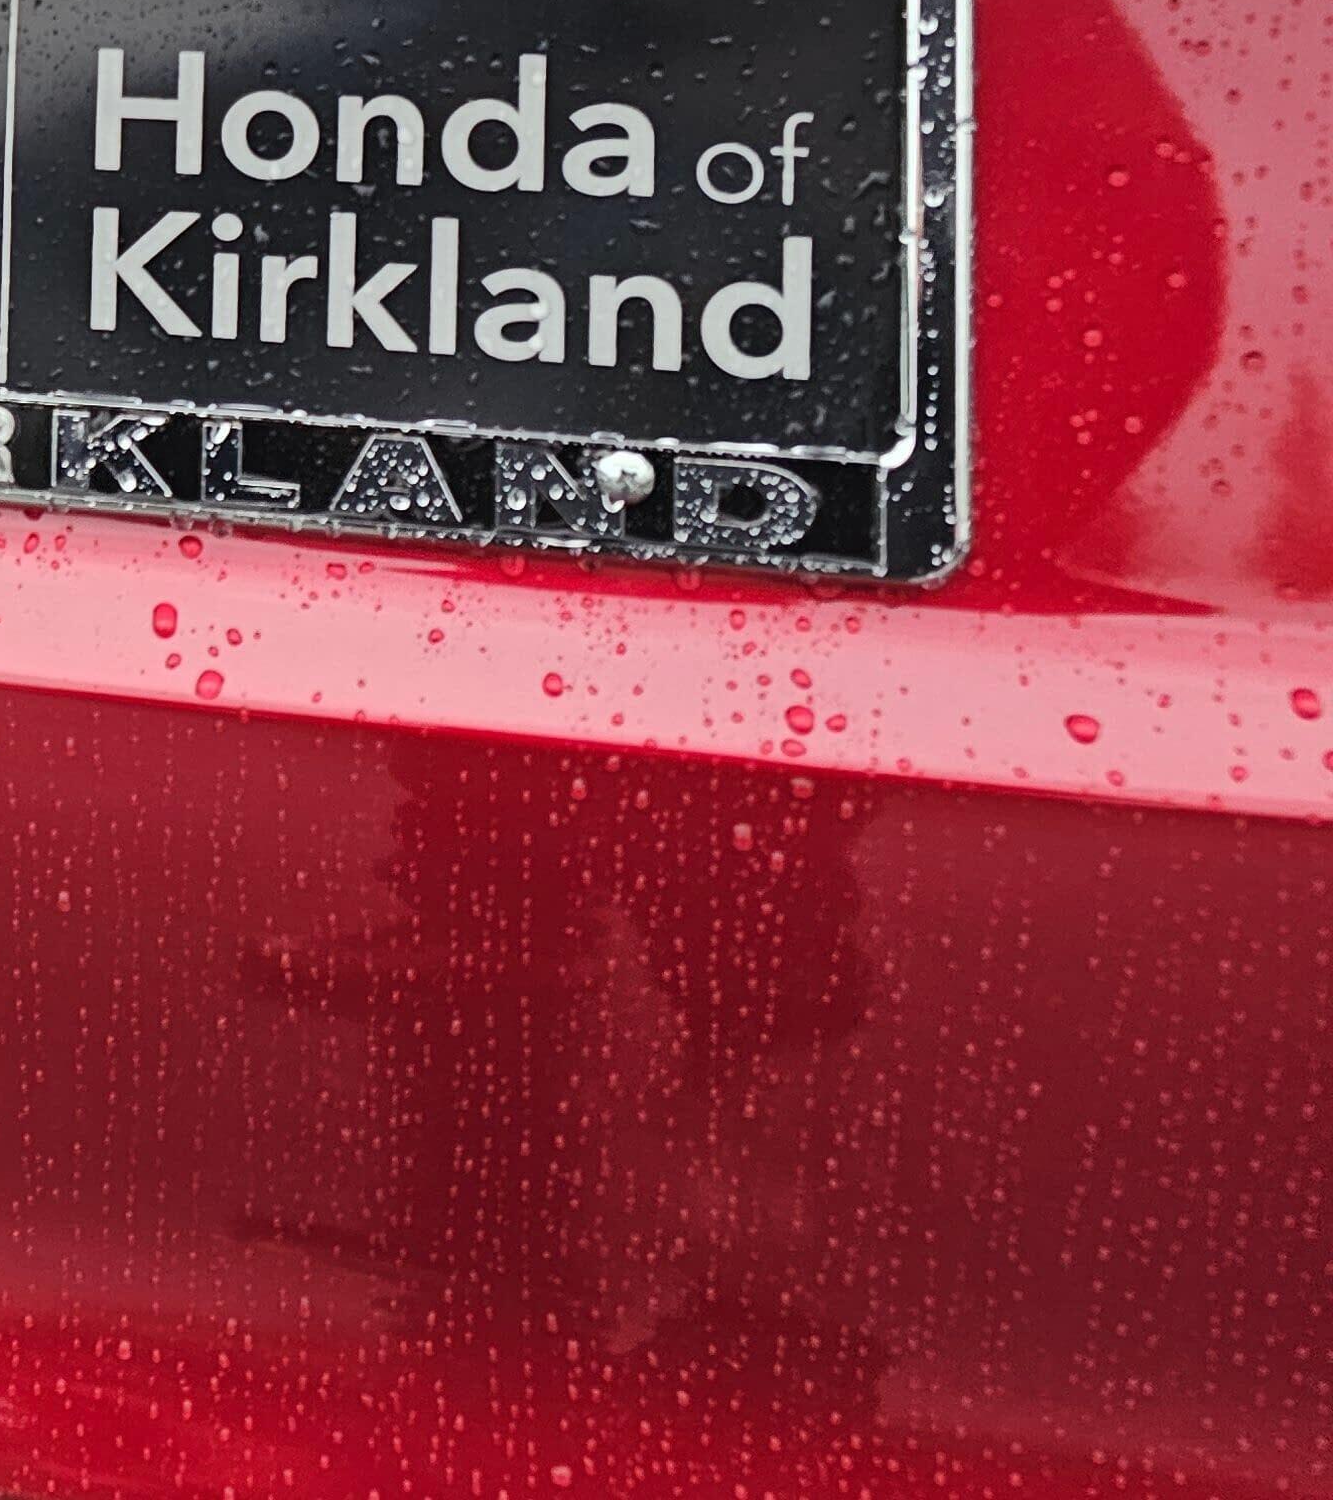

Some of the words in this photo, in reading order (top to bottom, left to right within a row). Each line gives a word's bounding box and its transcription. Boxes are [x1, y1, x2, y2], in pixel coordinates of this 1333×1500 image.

[93, 46, 656, 198] Honda
[695, 111, 814, 207] of
[89, 205, 813, 382] Kirkland
